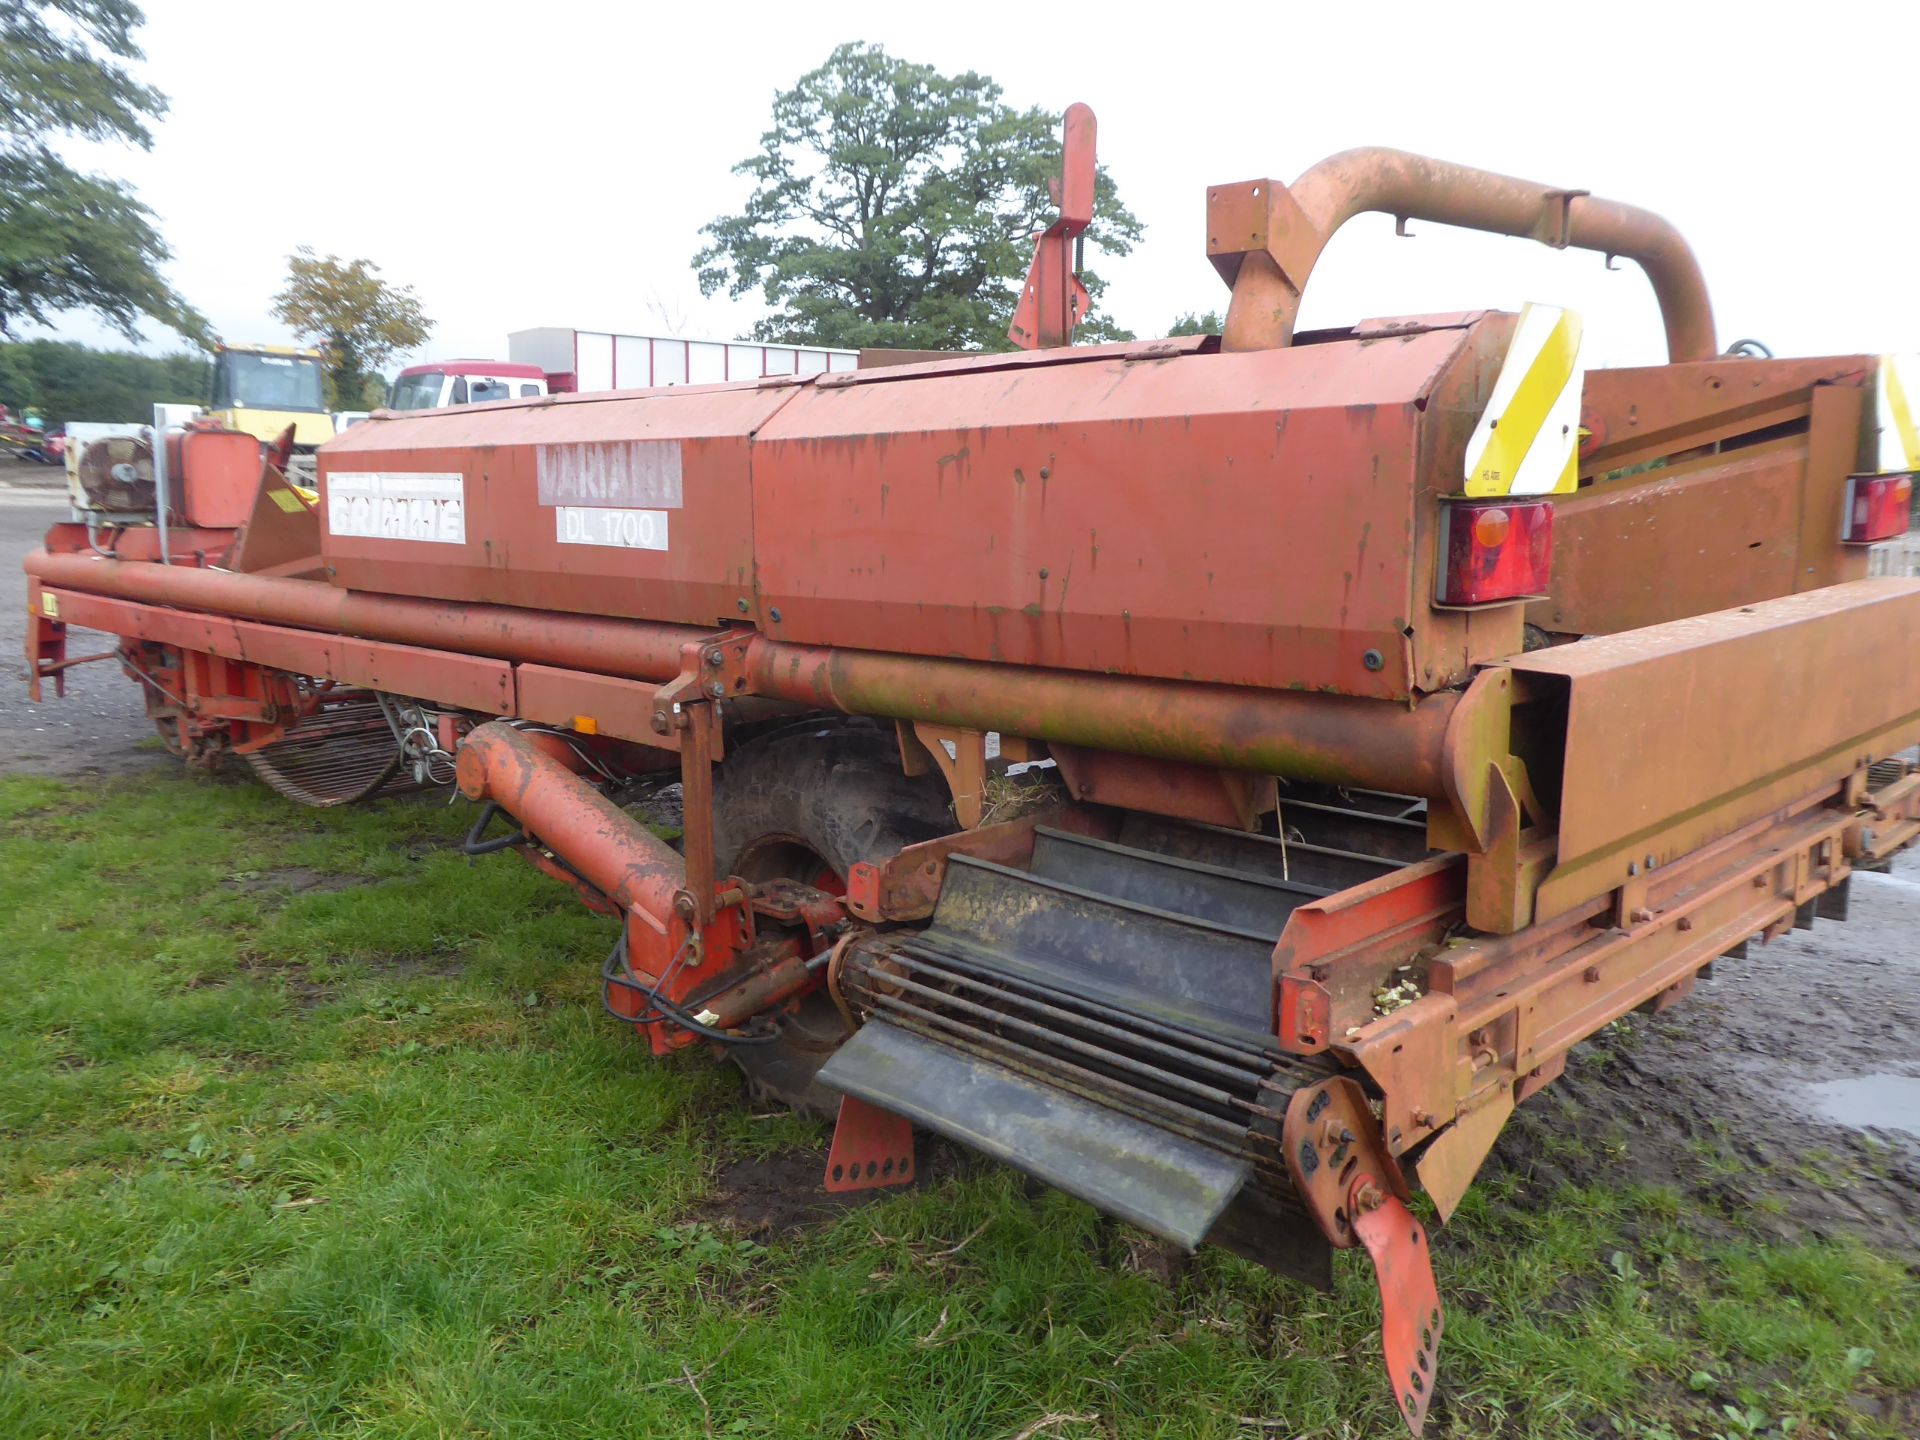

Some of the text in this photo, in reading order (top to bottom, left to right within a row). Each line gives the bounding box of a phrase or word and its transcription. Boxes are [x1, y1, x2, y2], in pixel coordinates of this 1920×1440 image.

[331, 495, 461, 540] GRIMME
[565, 510, 654, 546] DL 1700
